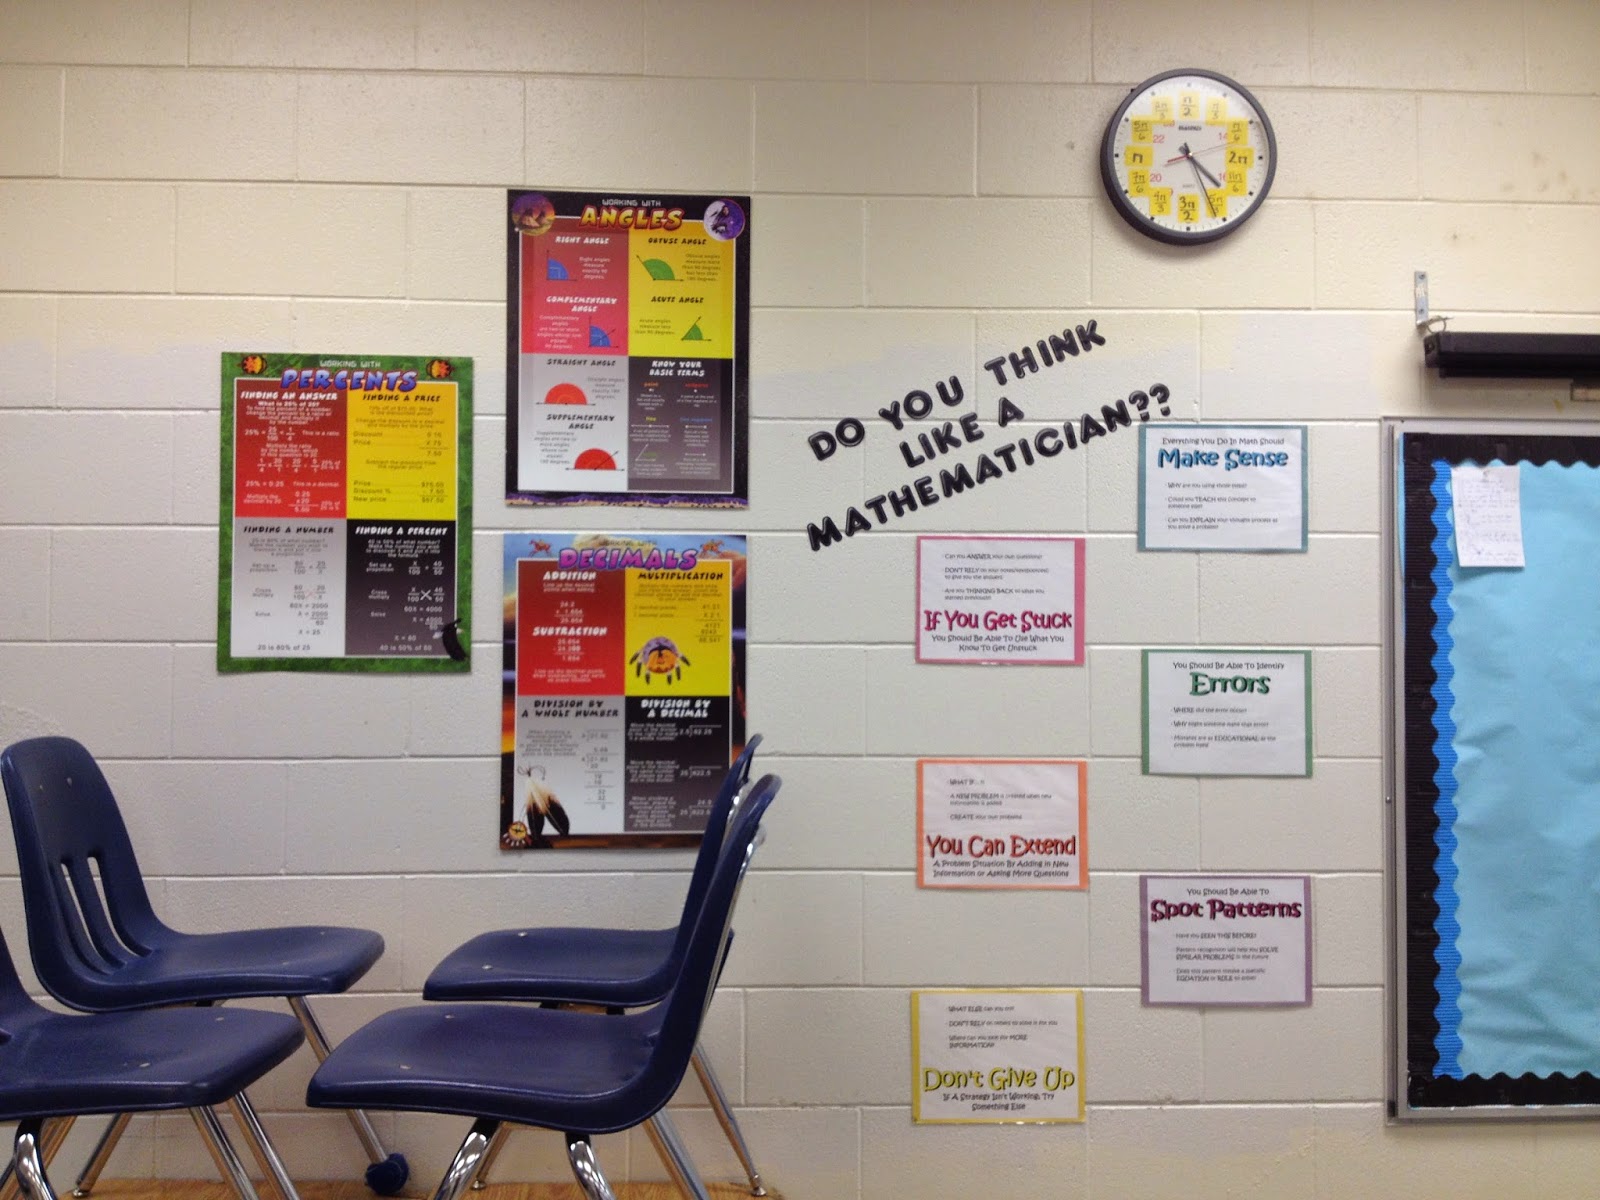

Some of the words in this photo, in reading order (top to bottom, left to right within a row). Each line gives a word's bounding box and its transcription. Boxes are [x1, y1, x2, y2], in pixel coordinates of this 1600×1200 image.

[602, 199, 638, 207] WORKING
[642, 199, 661, 207] WITH
[579, 206, 684, 232] ANGLES
[1183, 211, 1192, 221] 2
[546, 296, 617, 304] COMPLEMENTARY
[320, 360, 357, 368] WORKING
[360, 360, 381, 368] WITH
[547, 359, 587, 367] STRAIGHT
[591, 359, 616, 367] ANGLE
[650, 369, 673, 377] BASIC
[677, 369, 704, 377] TERMS
[280, 368, 417, 392] PERCENTS
[808, 417, 865, 461] DO
[878, 376, 964, 430] YOU
[984, 320, 1106, 385] THINK
[241, 392, 278, 400] FINDING
[283, 392, 296, 400] AN
[299, 392, 338, 400] ANSWER
[363, 394, 399, 402] FINDING
[404, 394, 410, 402] A
[414, 394, 440, 402] PRICE
[547, 414, 615, 422] SUPPLEMENTARY
[899, 412, 985, 468] LIKE
[998, 397, 1024, 427] A
[1162, 437, 1199, 445] Everything
[1260, 438, 1284, 446] Should
[1158, 448, 1220, 469] Make
[1225, 449, 1288, 471] Sense
[806, 383, 1171, 551] MATHEMATICIAN??
[356, 527, 393, 535] FINDING
[397, 527, 403, 535] A
[408, 527, 448, 535] PERCENT
[558, 547, 698, 571] DECIMALS
[543, 572, 597, 581] ADDITION
[924, 610, 943, 632] If
[944, 610, 979, 632] You
[983, 611, 1017, 631] Get
[1021, 610, 1072, 633] Stuck
[533, 627, 607, 636] SUBTRACTION
[932, 635, 945, 643] You
[948, 635, 972, 643] Should
[974, 635, 983, 643] Be
[985, 635, 1001, 643] Able
[1003, 635, 1013, 643] To
[1030, 635, 1048, 643] What
[1050, 635, 1064, 643] You
[959, 644, 979, 652] Know
[981, 644, 991, 652] To
[992, 644, 1006, 652] Get
[1008, 644, 1037, 652] Unstuck
[1173, 662, 1187, 670] You
[1189, 662, 1213, 670] Should
[1215, 662, 1224, 670] Be
[1226, 662, 1243, 670] Able
[1245, 662, 1255, 670] To
[1257, 662, 1284, 670] Identify
[1189, 672, 1271, 696] Errors
[534, 700, 583, 708] DIVISION
[589, 700, 603, 708] BY
[641, 700, 690, 708] DIVISION
[694, 700, 710, 708] BY
[522, 709, 528, 717] A
[535, 709, 569, 717] WHOLE
[575, 709, 619, 717] NUMBER
[648, 709, 655, 718] A
[660, 709, 708, 718] DECIMAL
[926, 835, 962, 858] You
[968, 835, 1005, 858] Can
[1010, 834, 1076, 858] Extend
[933, 860, 940, 868] A
[942, 860, 970, 868] Problem
[972, 860, 1005, 868] Situation
[1007, 860, 1014, 868] By
[1018, 860, 1042, 868] Adding
[1044, 860, 1051, 868] in
[1053, 860, 1069, 868] New
[933, 870, 975, 878] Information
[977, 870, 984, 878] or
[987, 870, 1010, 878] Asking
[1013, 870, 1031, 878] More
[1033, 870, 1069, 878] Questions
[1187, 888, 1201, 896] You
[1203, 888, 1227, 896] Should
[1229, 888, 1238, 896] Be
[1240, 888, 1258, 896] Able
[1259, 888, 1269, 896] To
[1151, 899, 1204, 922] Spot
[1207, 899, 1302, 921] Patterns
[923, 1067, 984, 1092] Don't
[988, 1066, 1037, 1091] Give
[1043, 1066, 1075, 1091] Up
[943, 1093, 949, 1101] If
[951, 1093, 958, 1101] A
[960, 1093, 989, 1101] Strategy
[992, 1093, 1007, 1101] Isn't
[1042, 1093, 1054, 1101] Try
[972, 1103, 1009, 1111] Something
[1011, 1103, 1026, 1111] Else
